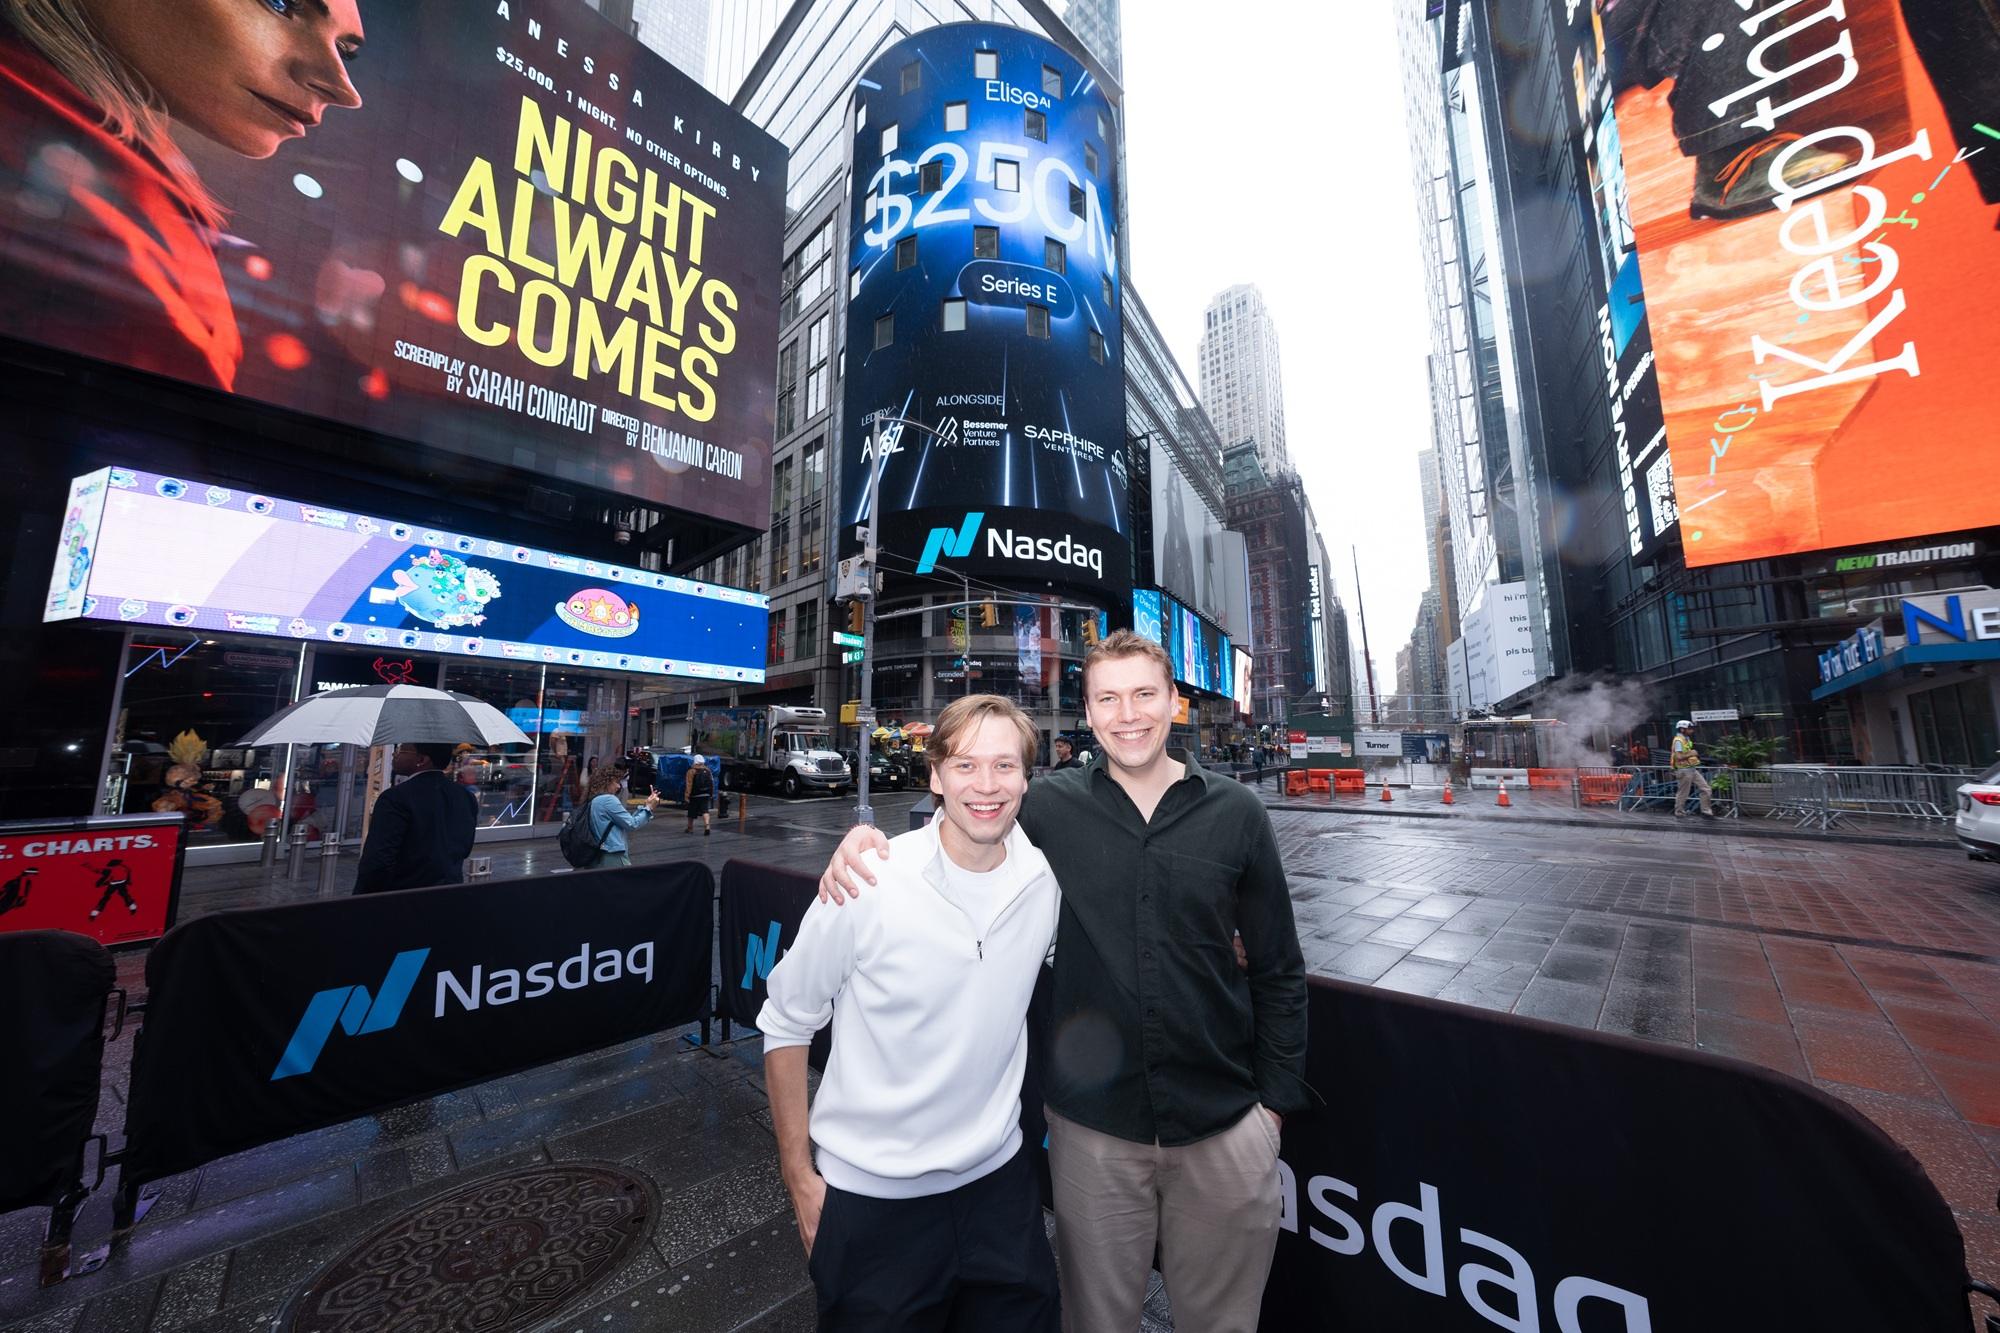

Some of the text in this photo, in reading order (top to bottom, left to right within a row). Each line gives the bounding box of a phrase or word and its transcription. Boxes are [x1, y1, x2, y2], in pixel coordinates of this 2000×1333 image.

[566, 90, 573, 104] 1
[577, 97, 617, 132] NIGHT.
[626, 127, 643, 147] NO
[646, 139, 682, 170] OTHER
[684, 162, 730, 200] OPTIONS.
[673, 115, 760, 182] KIRBY
[514, 95, 717, 266] NIGHT
[438, 156, 738, 355] ALWAYS
[1751, 125, 1934, 412] Keep
[981, 274, 1058, 304] Series E
[456, 254, 719, 422] COMES
[394, 340, 465, 378] SCREENPLAY
[446, 377, 463, 395] BY
[466, 364, 598, 435] SARAH CONRADT
[936, 394, 1003, 407] ALONGSIDE
[601, 407, 640, 434] DIRECTED
[963, 419, 1008, 430] Bessemer
[963, 429, 997, 438] Venture
[1597, 303, 1644, 558] RESERVE NOW
[626, 430, 639, 448] BY
[641, 422, 743, 480] BENJAMIN CARON
[963, 437, 1001, 447] Partners
[1024, 425, 1105, 460] SAPPHIRE
[1042, 442, 1094, 462] VENTURES
[987, 528, 1103, 579] Nasdaq
[1504, 594, 1513, 602] hi
[1509, 615, 1527, 623] this
[962, 660, 982, 668] Nsdaq
[1505, 648, 1520, 657] pls
[1364, 741, 1390, 750] Turner
[22, 835, 159, 858] CHARTS.
[434, 941, 655, 1019] Nasdaq
